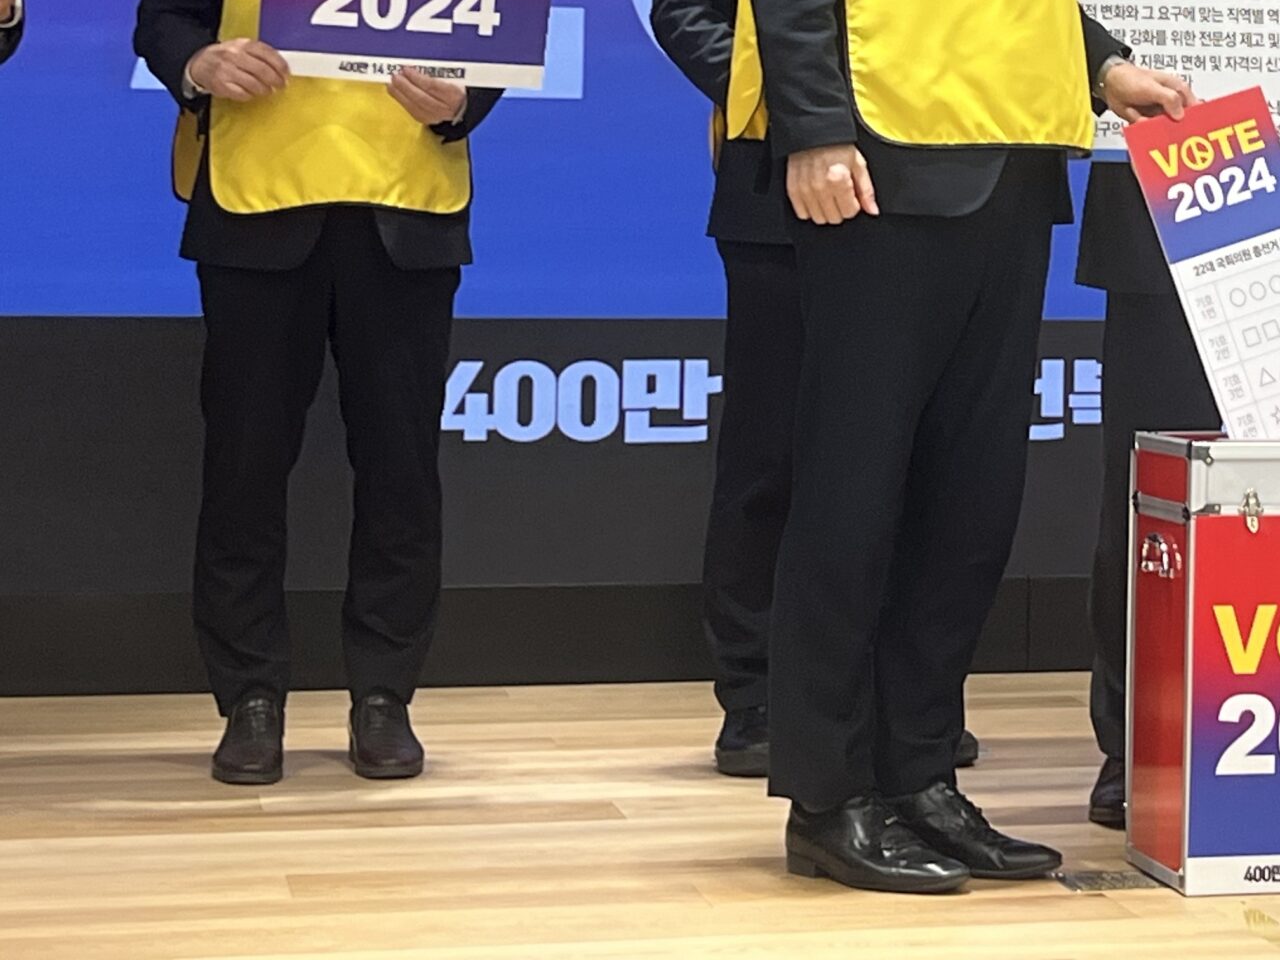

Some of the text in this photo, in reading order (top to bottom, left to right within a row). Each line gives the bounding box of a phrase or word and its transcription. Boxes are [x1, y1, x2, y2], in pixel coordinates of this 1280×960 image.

[1100, 4, 1139, 20] 변화와
[1141, 5, 1155, 20] 그
[1157, 6, 1195, 22] 요구에
[1198, 6, 1224, 23] 맞는
[1227, 8, 1264, 24] 직역별
[1129, 28, 1166, 46] 강화를
[1171, 29, 1196, 47] 위한
[1200, 31, 1237, 48] 전문성
[1240, 32, 1265, 48] 제고
[1268, 33, 1280, 49] 및
[1140, 53, 1178, 70] 지원과
[1181, 54, 1206, 71] 면허
[1209, 55, 1222, 72] 및
[1224, 56, 1262, 73] 자격의
[1149, 119, 1266, 178] VOTE
[1167, 157, 1277, 222] 2024
[440, 359, 723, 443] 400만
